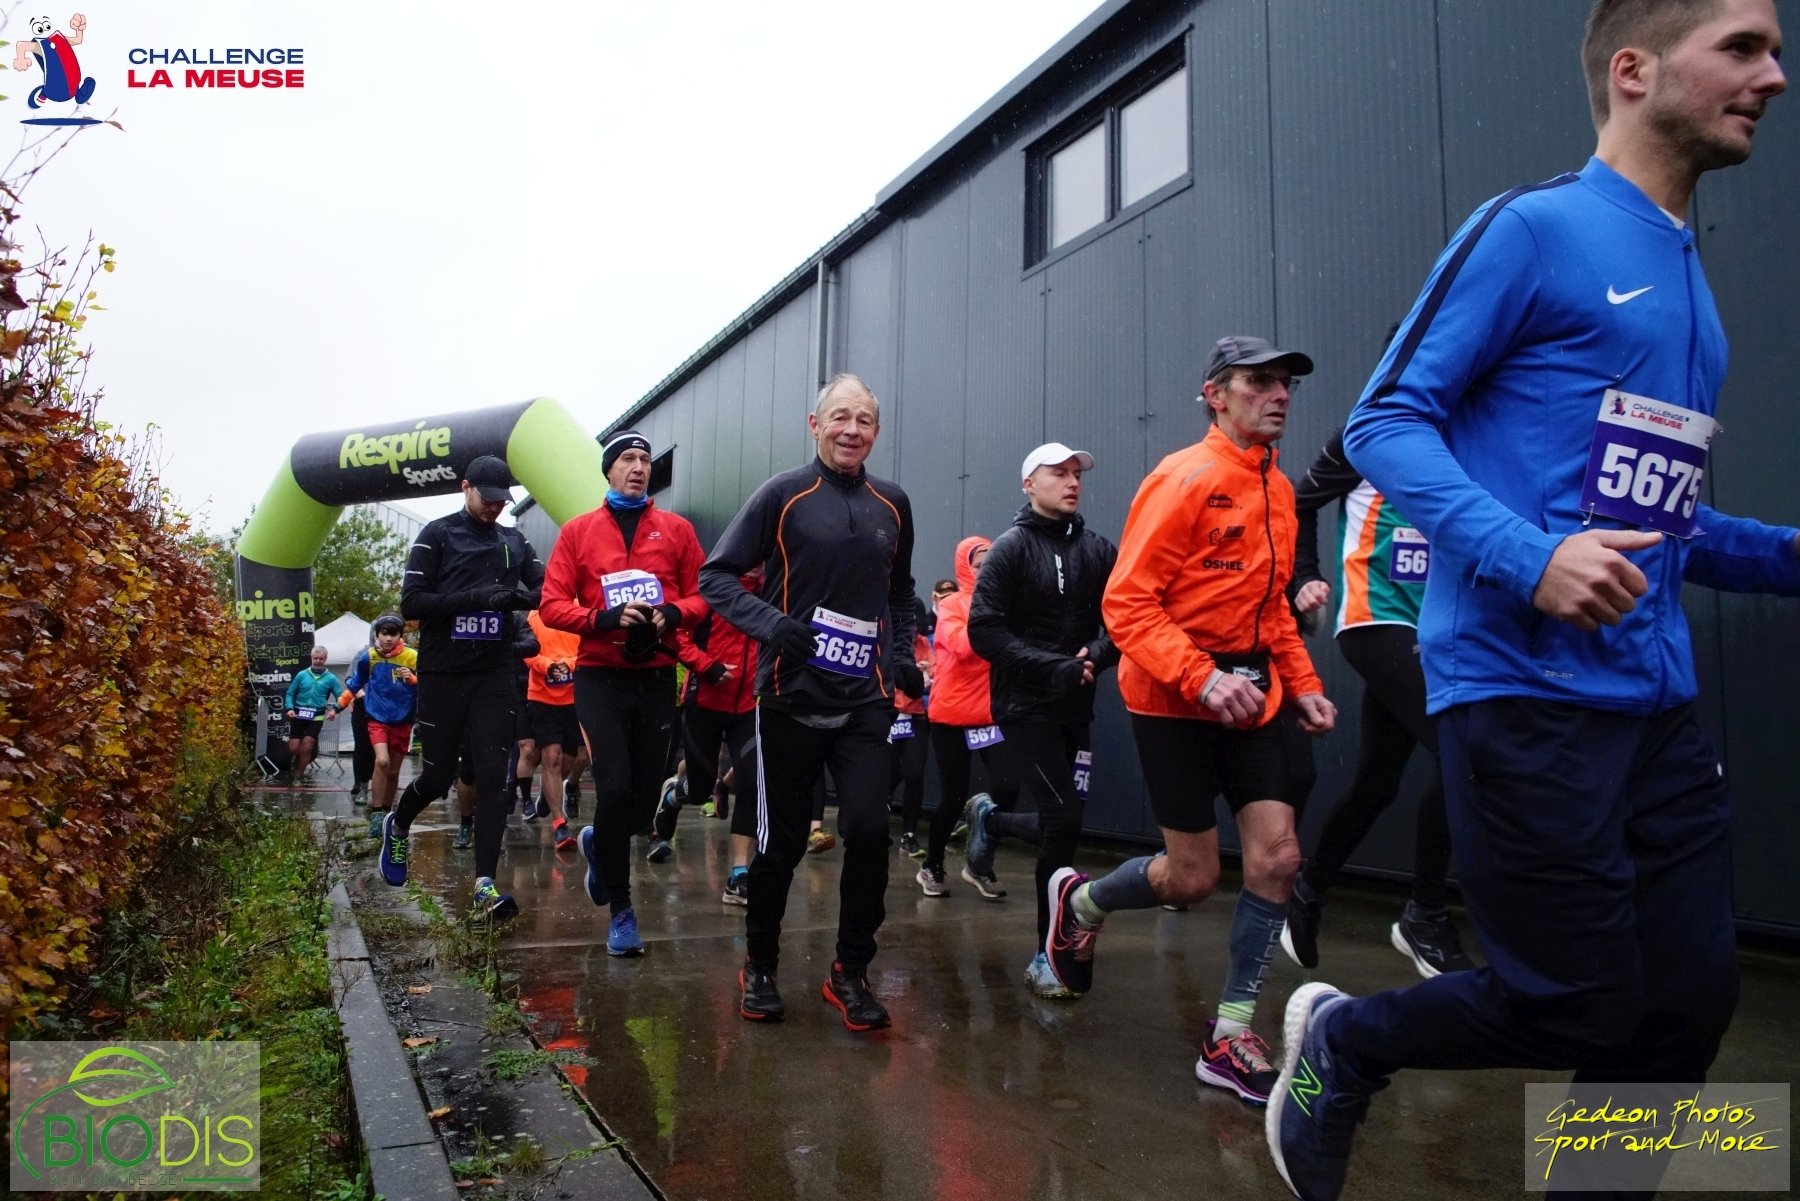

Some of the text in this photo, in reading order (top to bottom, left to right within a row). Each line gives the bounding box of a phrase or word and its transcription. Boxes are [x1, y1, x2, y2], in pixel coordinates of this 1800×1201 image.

[1630, 410, 1683, 430] LA MEUSE
[1632, 403, 1685, 422] CHALLENGE
[339, 420, 451, 475] Respire
[402, 464, 457, 487] Sports
[1597, 442, 1704, 519] 5675
[1203, 559, 1244, 571] OSHEE
[1395, 549, 1428, 574] 56
[608, 581, 659, 607] 5625
[455, 616, 499, 634] 5613
[813, 632, 872, 669] 5635
[275, 658, 299, 667] Sports
[248, 669, 292, 685] Respire
